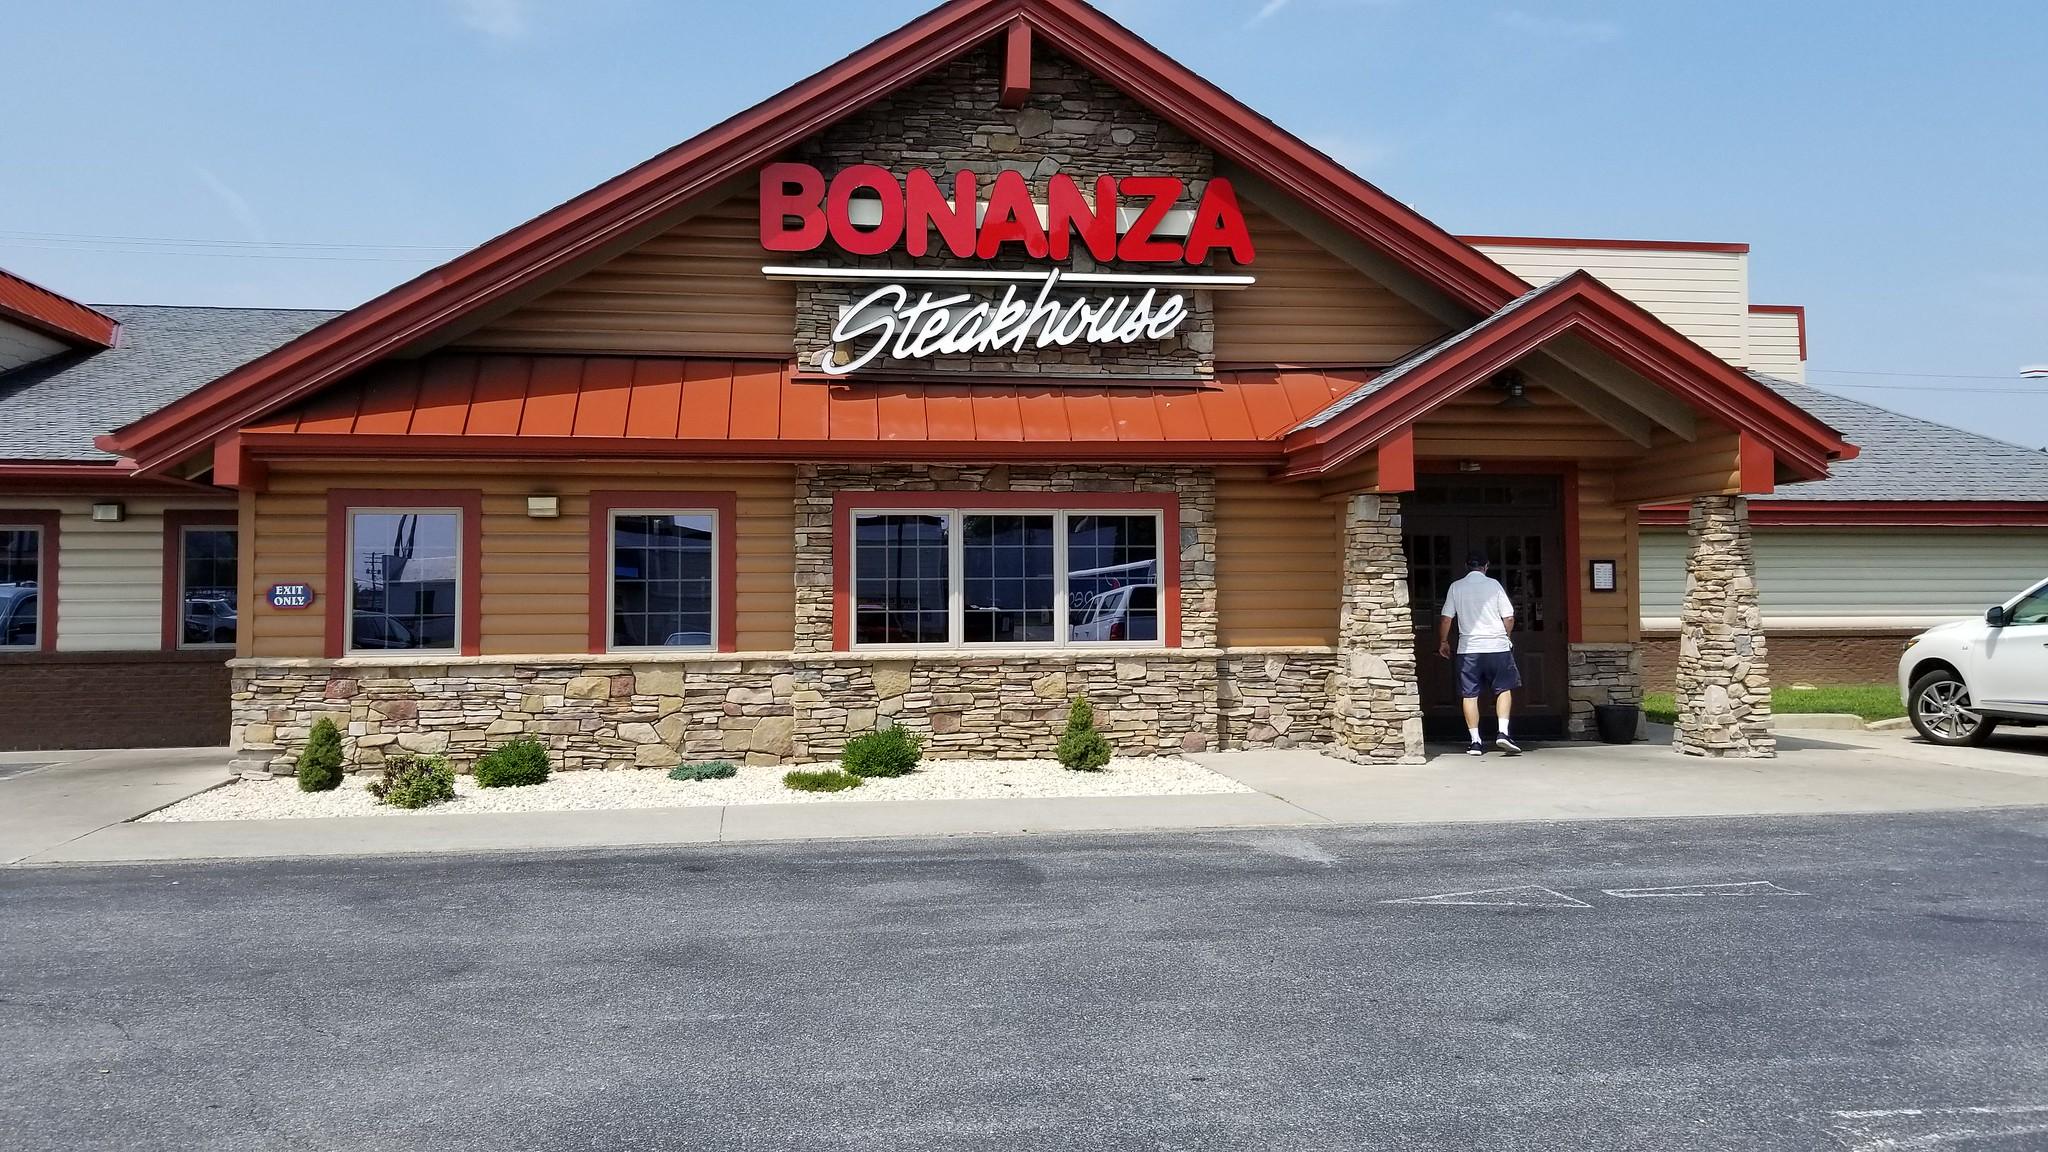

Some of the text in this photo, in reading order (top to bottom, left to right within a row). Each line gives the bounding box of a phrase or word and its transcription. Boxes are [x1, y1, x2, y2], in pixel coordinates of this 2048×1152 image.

[760, 162, 1256, 265] BONANZA
[821, 268, 1188, 375] Steakhouse
[273, 596, 305, 606] ONLY
[275, 585, 304, 595] EXIT
